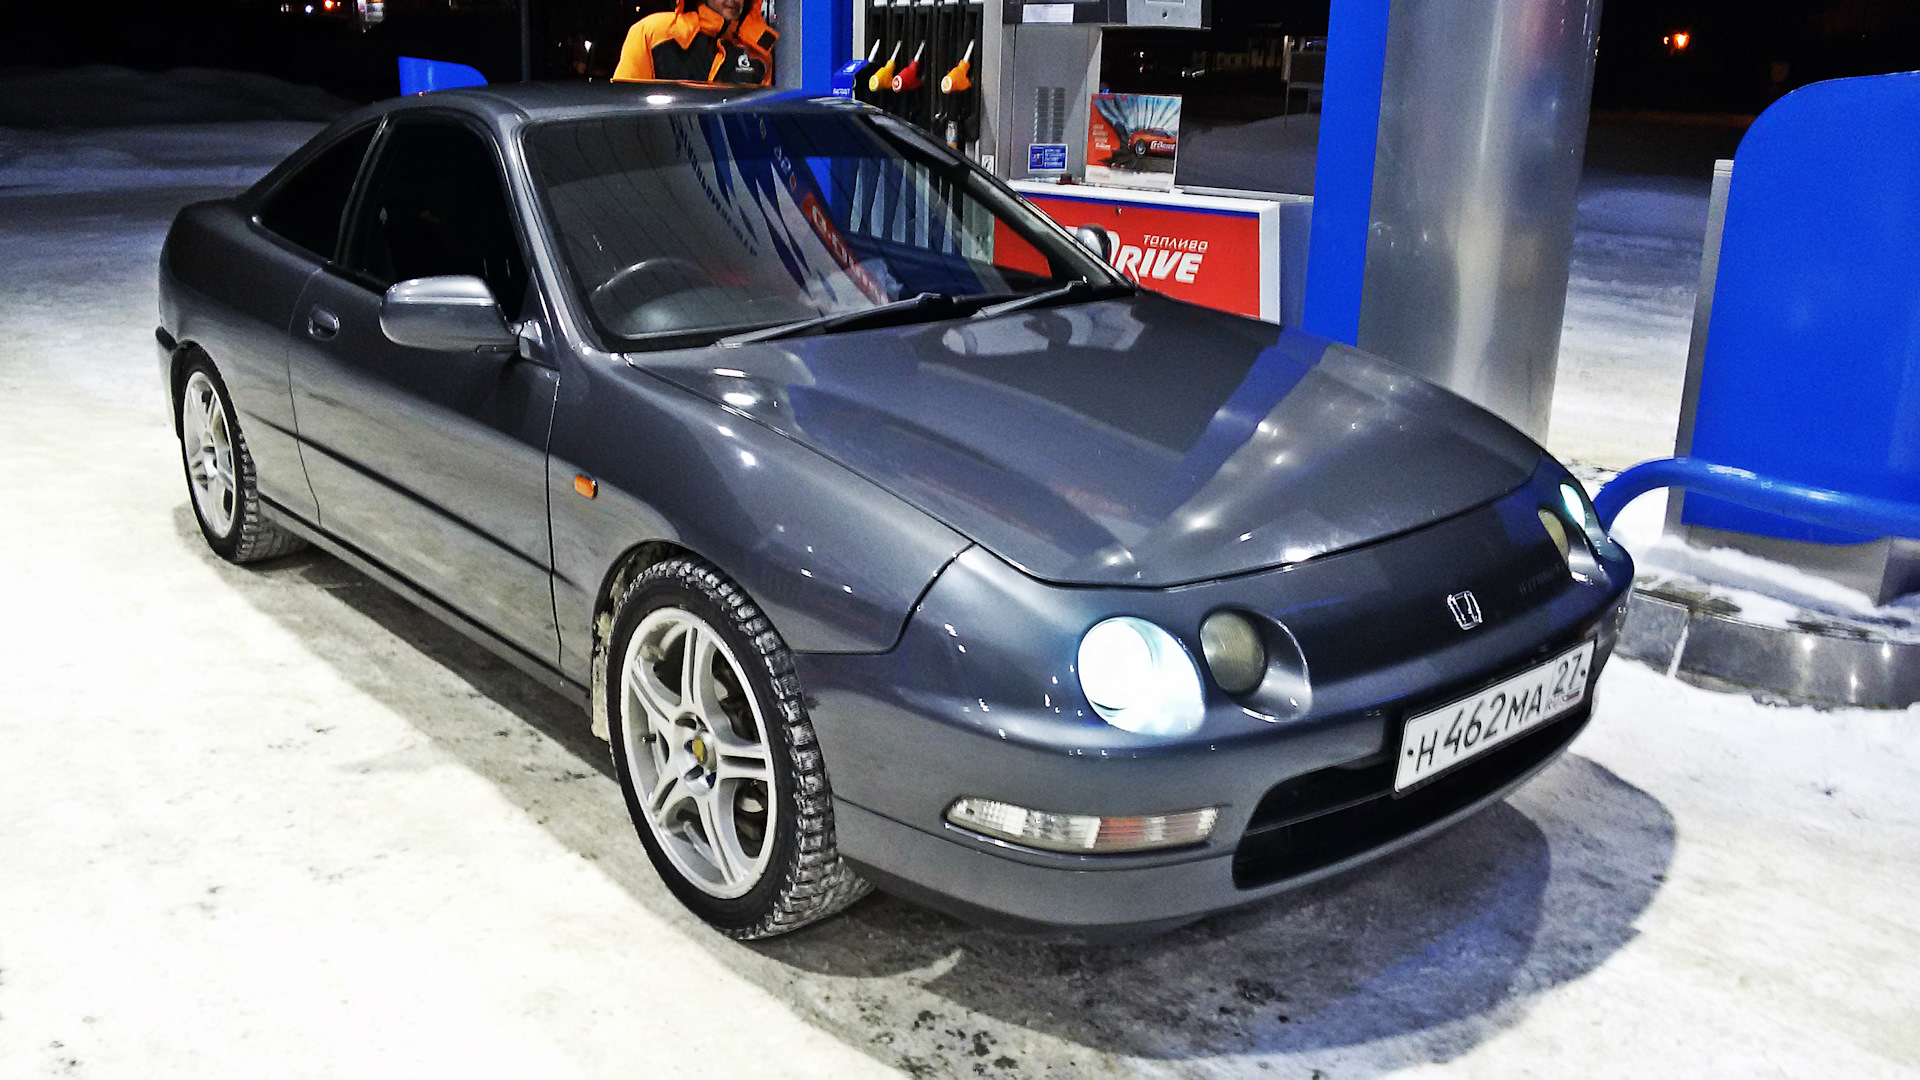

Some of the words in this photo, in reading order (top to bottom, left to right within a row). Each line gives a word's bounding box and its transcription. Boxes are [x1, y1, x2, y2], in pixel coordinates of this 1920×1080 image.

[1065, 225, 1204, 284] DRIVE
[1143, 234, 1209, 253] ТОПЛИВО
[1552, 651, 1583, 695] 27
